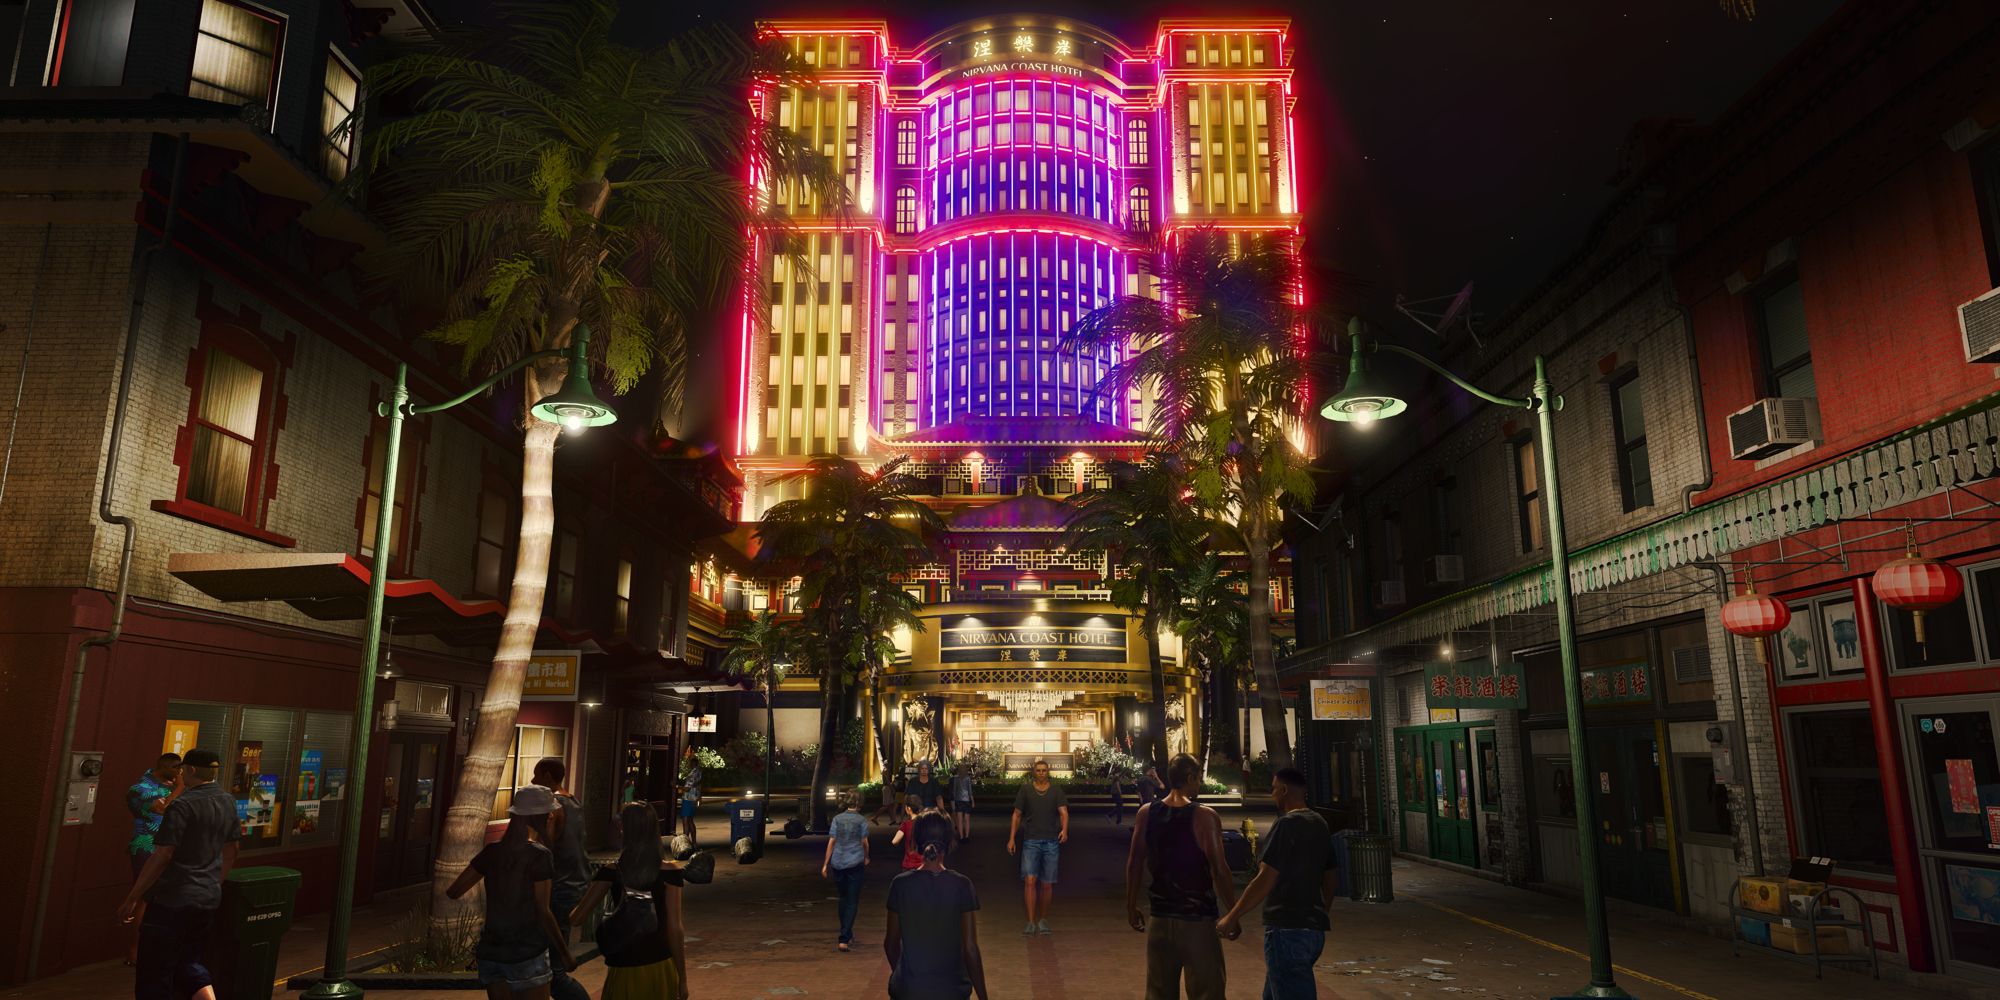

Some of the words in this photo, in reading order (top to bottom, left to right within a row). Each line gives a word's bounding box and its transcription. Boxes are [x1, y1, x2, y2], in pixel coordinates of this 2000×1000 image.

[962, 63, 1008, 78] NIRVANA
[1011, 62, 1048, 72] COAST
[1051, 64, 1082, 78] HOTEL
[960, 632, 1016, 645] NIRVANA
[1020, 632, 1065, 644] COAST
[1069, 632, 1111, 645] HOTEL
[242, 746, 262, 758] Beer
